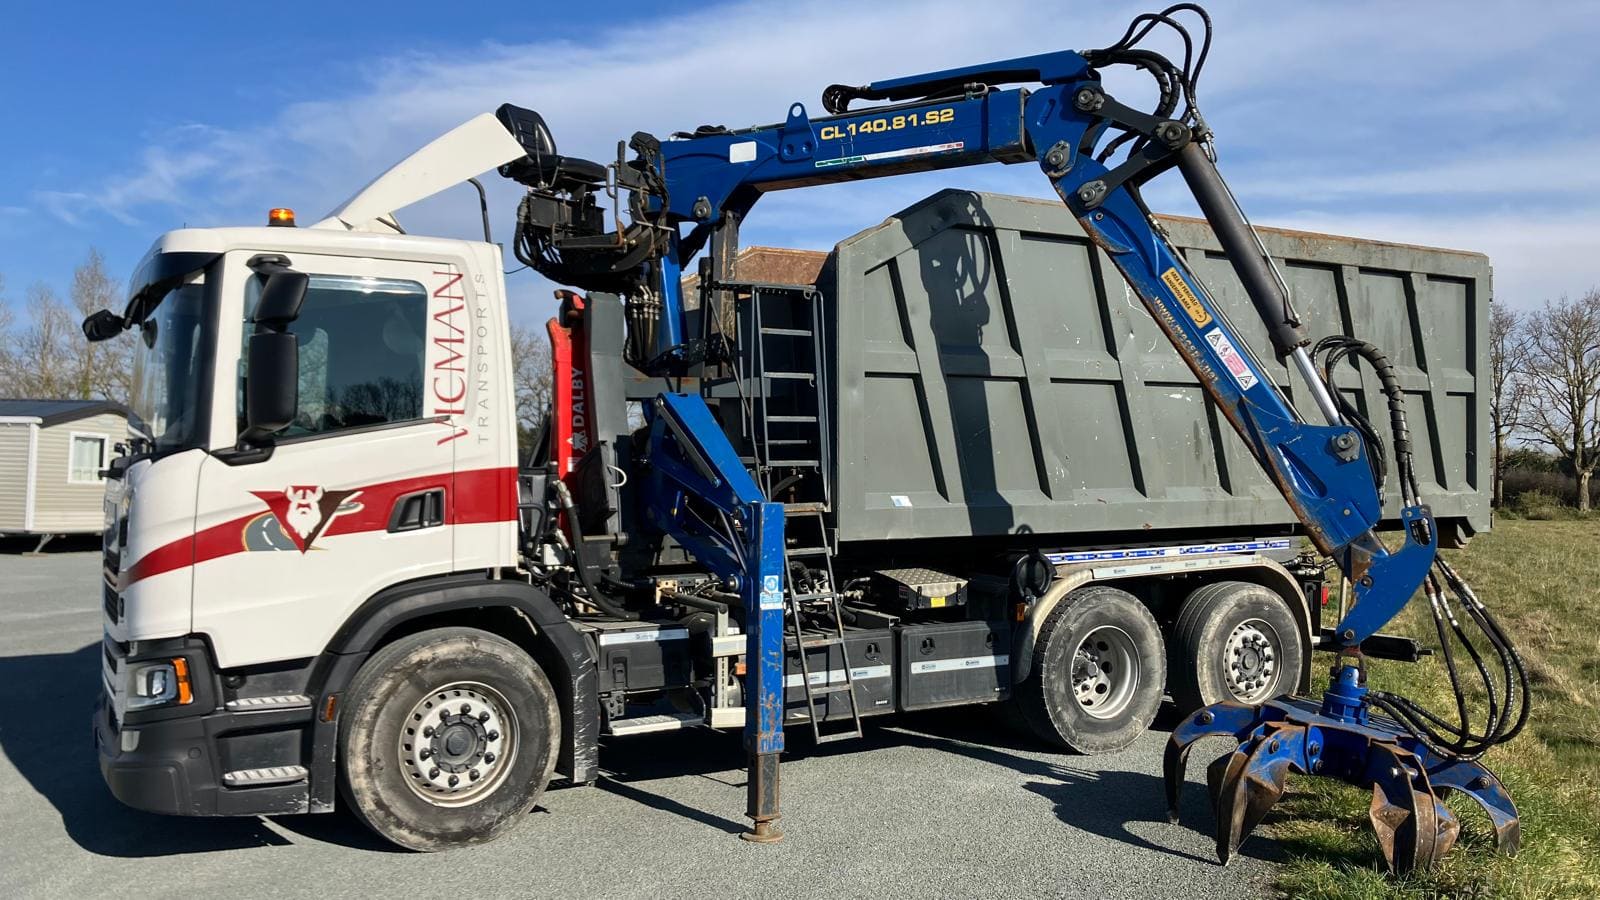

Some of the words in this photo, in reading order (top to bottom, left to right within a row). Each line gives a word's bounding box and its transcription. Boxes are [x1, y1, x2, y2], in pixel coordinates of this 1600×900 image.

[820, 108, 955, 140] CL140.81.S2
[432, 270, 468, 446] VICMAN
[475, 273, 489, 444] TRANSPORTS
[572, 367, 585, 427] DALBY
